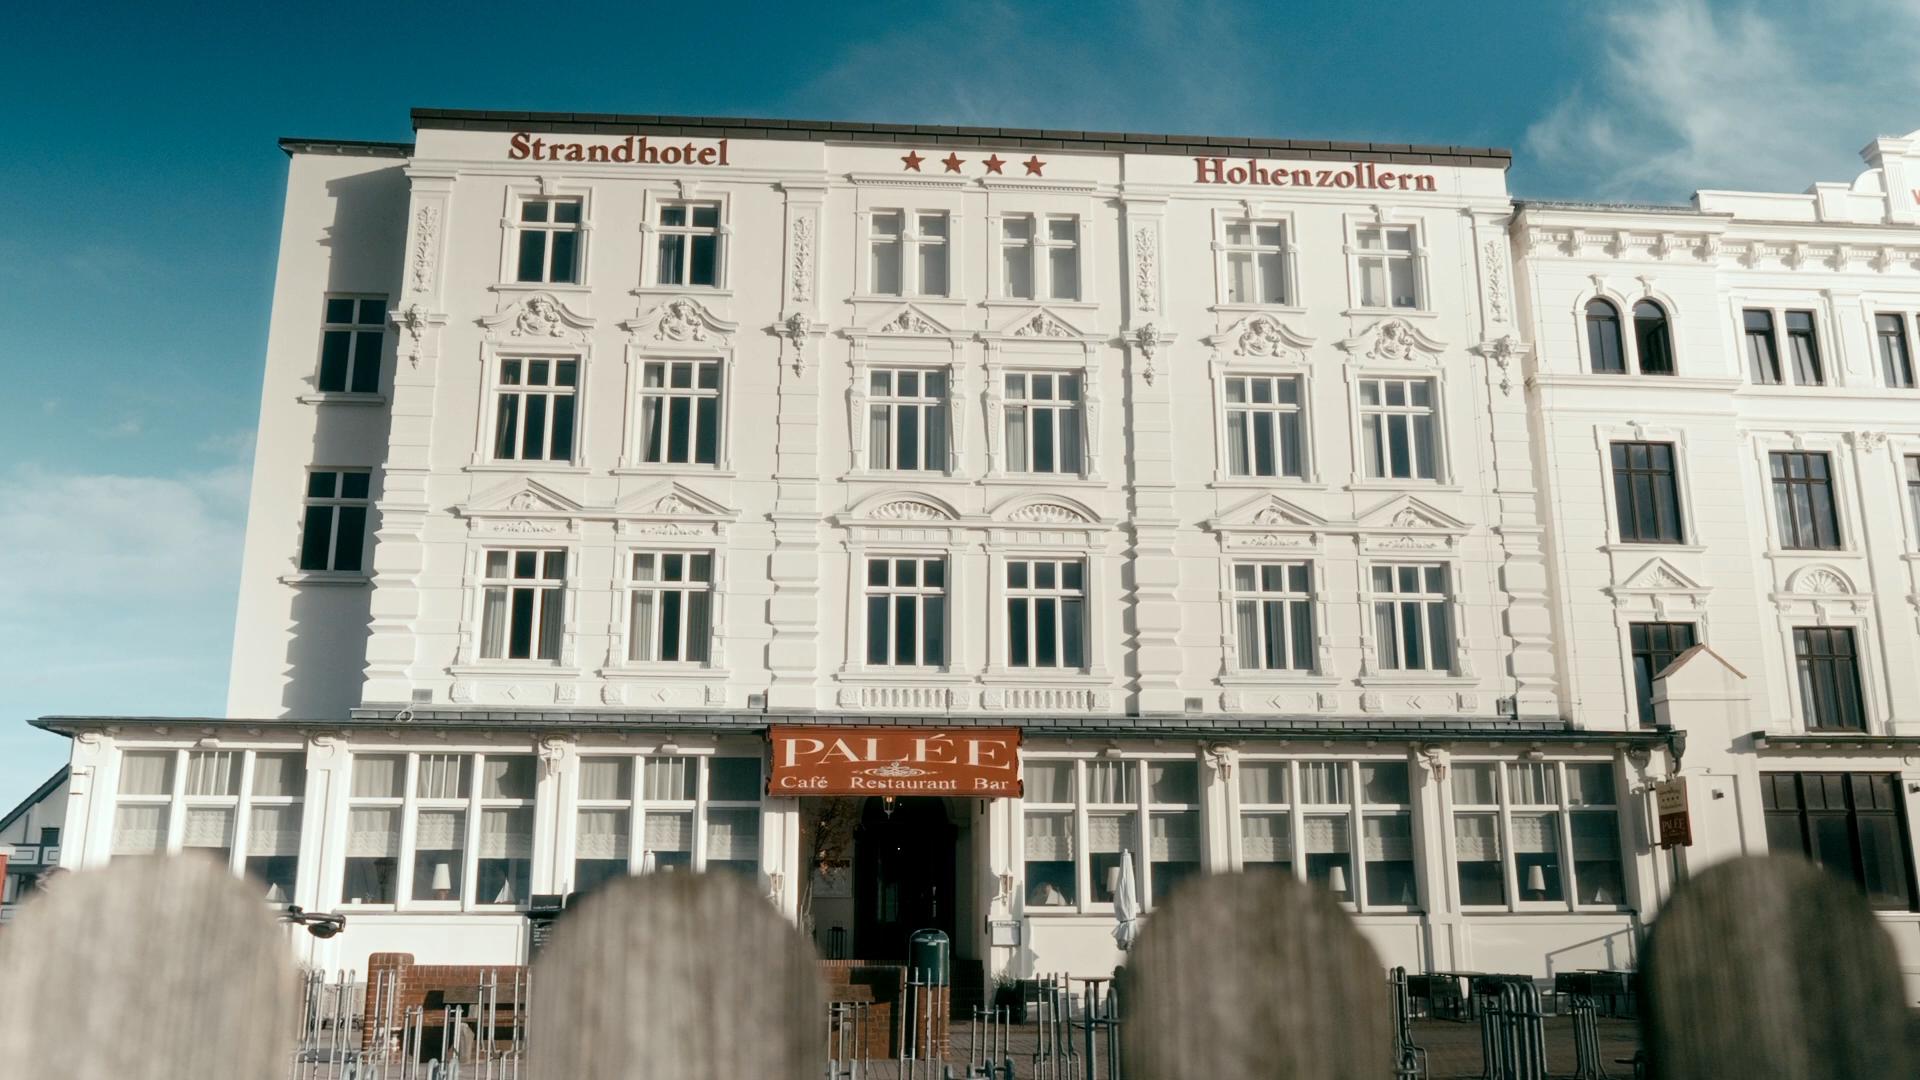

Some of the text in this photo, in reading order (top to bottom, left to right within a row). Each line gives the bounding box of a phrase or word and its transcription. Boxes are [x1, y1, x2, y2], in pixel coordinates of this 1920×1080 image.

[508, 132, 729, 166] Strandhotel
[1193, 157, 1437, 192] Hohenzollern
[779, 733, 1010, 770] PALÉE
[780, 776, 1009, 790] Café Restaurant Bar
